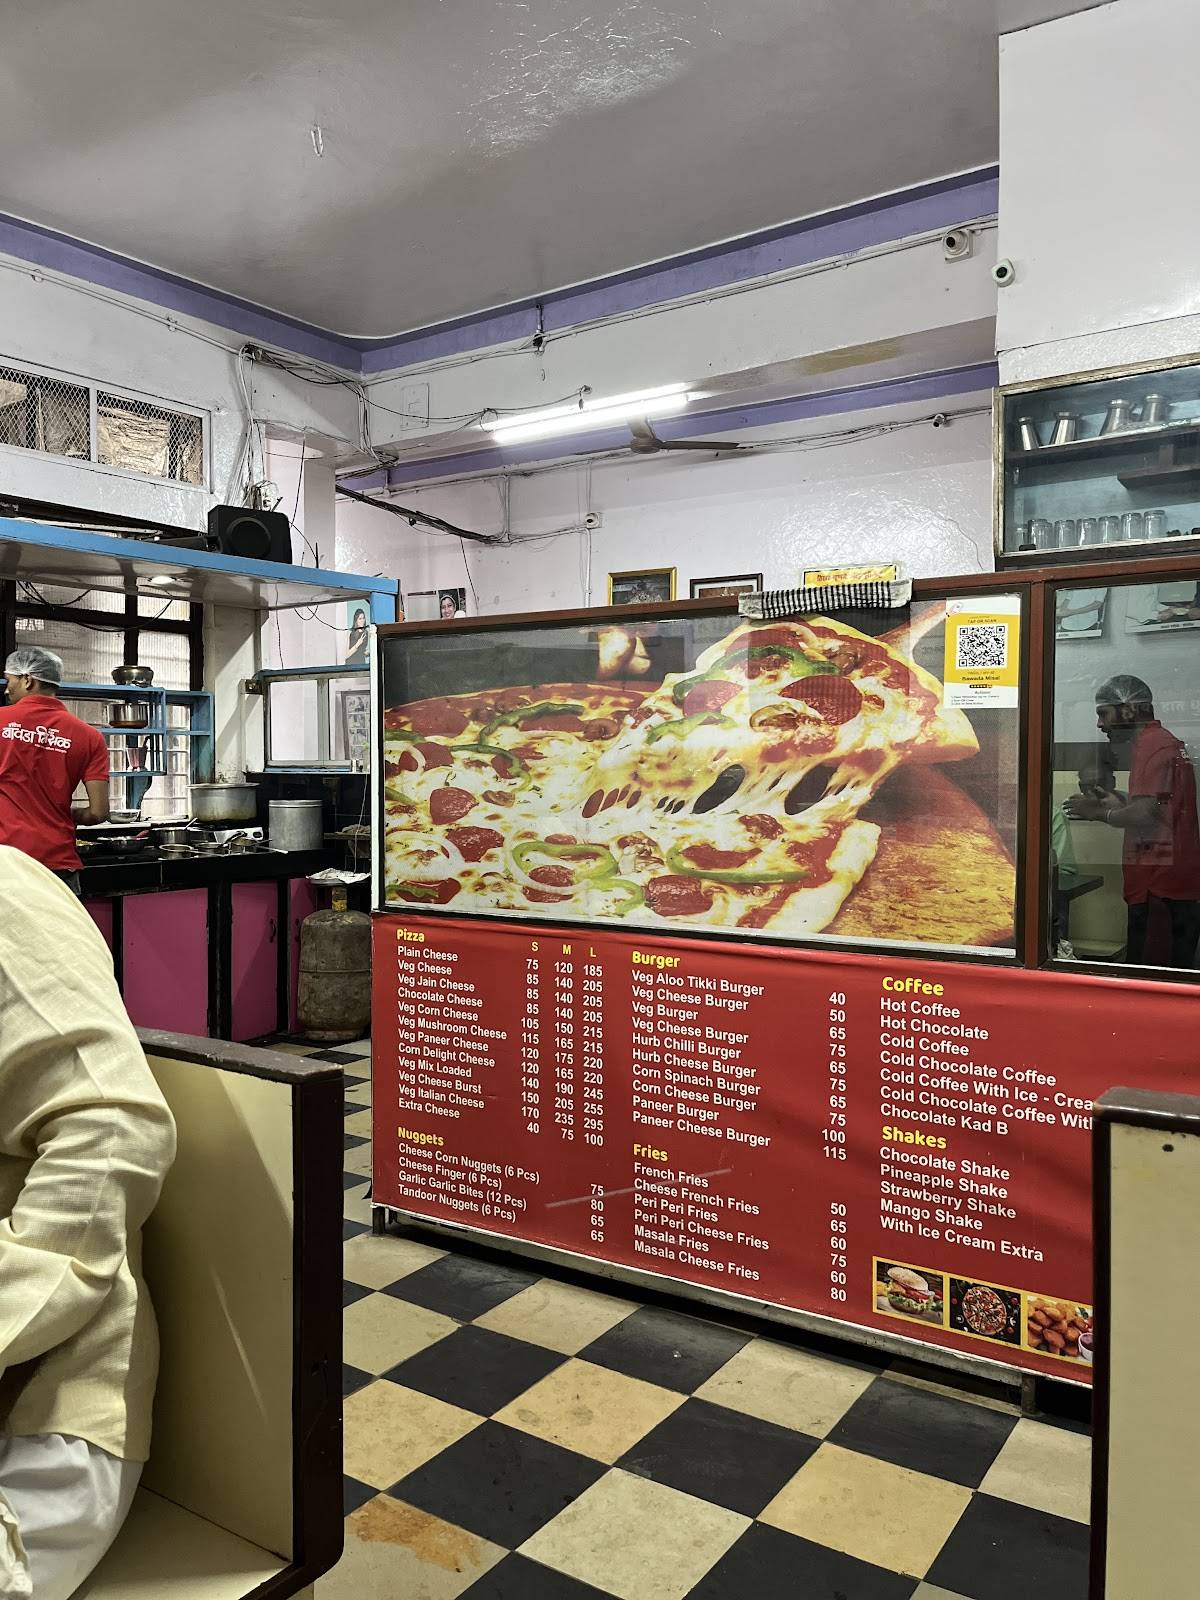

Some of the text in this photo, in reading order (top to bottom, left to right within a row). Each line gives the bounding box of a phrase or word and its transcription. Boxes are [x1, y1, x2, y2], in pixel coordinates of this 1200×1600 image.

[397, 928, 425, 942] Pizza
[531, 941, 596, 957] S M L
[398, 946, 602, 977] Plain Cheese 75 120 185
[398, 959, 602, 992] Veg Cheese 85 140 205
[632, 951, 680, 969] Burger
[398, 987, 603, 1023] Chocolate Cheese 85 140 205
[632, 969, 846, 1005] Veg Aloo Tikki Burger 40
[632, 985, 846, 1022] Veg Cheese Burger 50
[882, 976, 944, 996] Coffee
[632, 1000, 846, 1040] Veg Burger 65
[880, 997, 960, 1018] Hot Coffee
[398, 1014, 603, 1054] Veg Mushroom Cheese 115 165 215
[880, 1014, 989, 1040] Hot Chocolate
[880, 1033, 969, 1056] Cold Coffee
[398, 1042, 603, 1084] Corn Delight Cheese 120 165 220
[632, 1032, 846, 1074] Hurb Chilli Burger 65
[880, 1050, 1056, 1086] Cold Chocolate Coffee
[398, 1070, 603, 1116] Veg Cheese Burst 150 205 255
[632, 1064, 846, 1109] Corn Spinach Burger 65
[880, 1068, 914, 1084] Cold
[919, 1073, 969, 1092] Coffee
[973, 1080, 1009, 1098] With
[1014, 1086, 1038, 1102] Ice
[1054, 1092, 1094, 1111] Crea
[880, 1086, 914, 1102] Cold
[919, 1092, 997, 1115] Chocolate
[1002, 1104, 1056, 1124] Coffee
[398, 1126, 444, 1146] Nuggets
[399, 1097, 603, 1146] Extra Cheese 40 75 100
[633, 1095, 846, 1144] Paneer Burger 100
[633, 1110, 846, 1160] Paneer Cheese Burger 115
[880, 1103, 1008, 1135] Chocolate Kad B
[882, 1126, 946, 1149] Shakes
[399, 1142, 604, 1196] Cheese Corn Nuggets (6 Pcs) 75
[634, 1144, 668, 1162] Fries
[880, 1146, 1010, 1180] Chocolate Shake
[399, 1156, 604, 1212] Cheese Finger (6 Pcs) 80
[634, 1162, 846, 1216] French Fries 50
[880, 1163, 1008, 1198] Pineapple Shake
[880, 1180, 1016, 1218] Strawberry Shake
[398, 1184, 604, 1242] Tandoor Nuggets (6 Pcs) 65
[634, 1178, 846, 1234] Cheese French Fries 65
[634, 1224, 846, 1284] Masala Fries 60
[635, 1208, 846, 1268] Peri Peri Cheese Fries 75
[880, 1215, 1043, 1262] With Ice Cream Extra
[634, 1240, 846, 1302] Masala Cheese Fries 80
